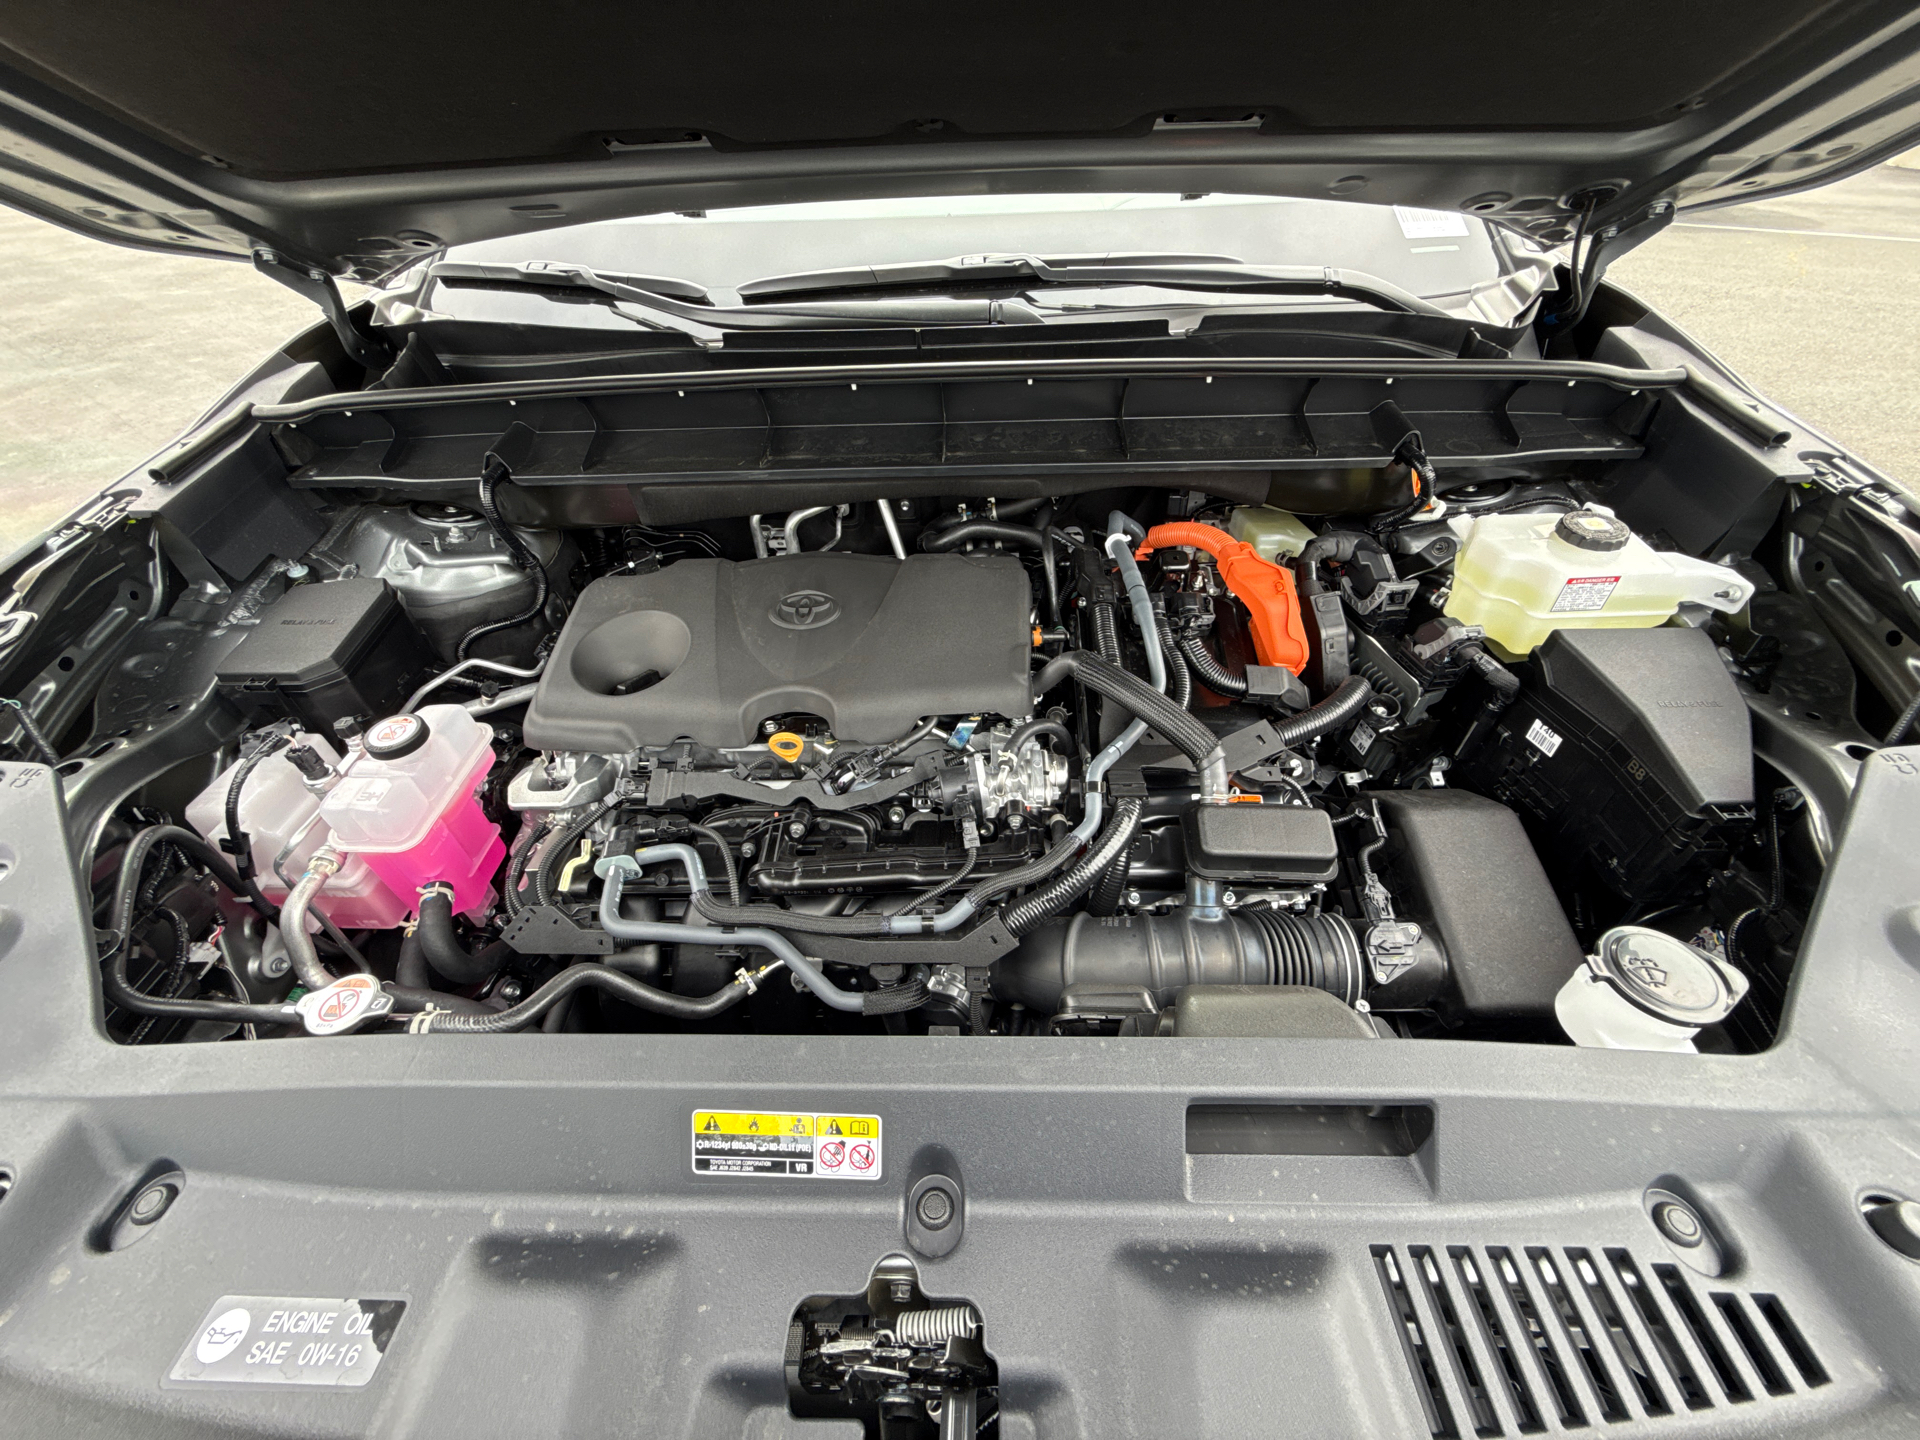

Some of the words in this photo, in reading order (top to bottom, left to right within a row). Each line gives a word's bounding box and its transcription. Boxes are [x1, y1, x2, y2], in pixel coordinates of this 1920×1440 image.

[1627, 759, 1647, 781] B8
[795, 1163, 807, 1173] VR
[262, 1311, 338, 1334] ENGINE
[344, 1312, 375, 1335] OIL
[245, 1341, 292, 1365] SAE
[297, 1343, 362, 1367] 0W-16
